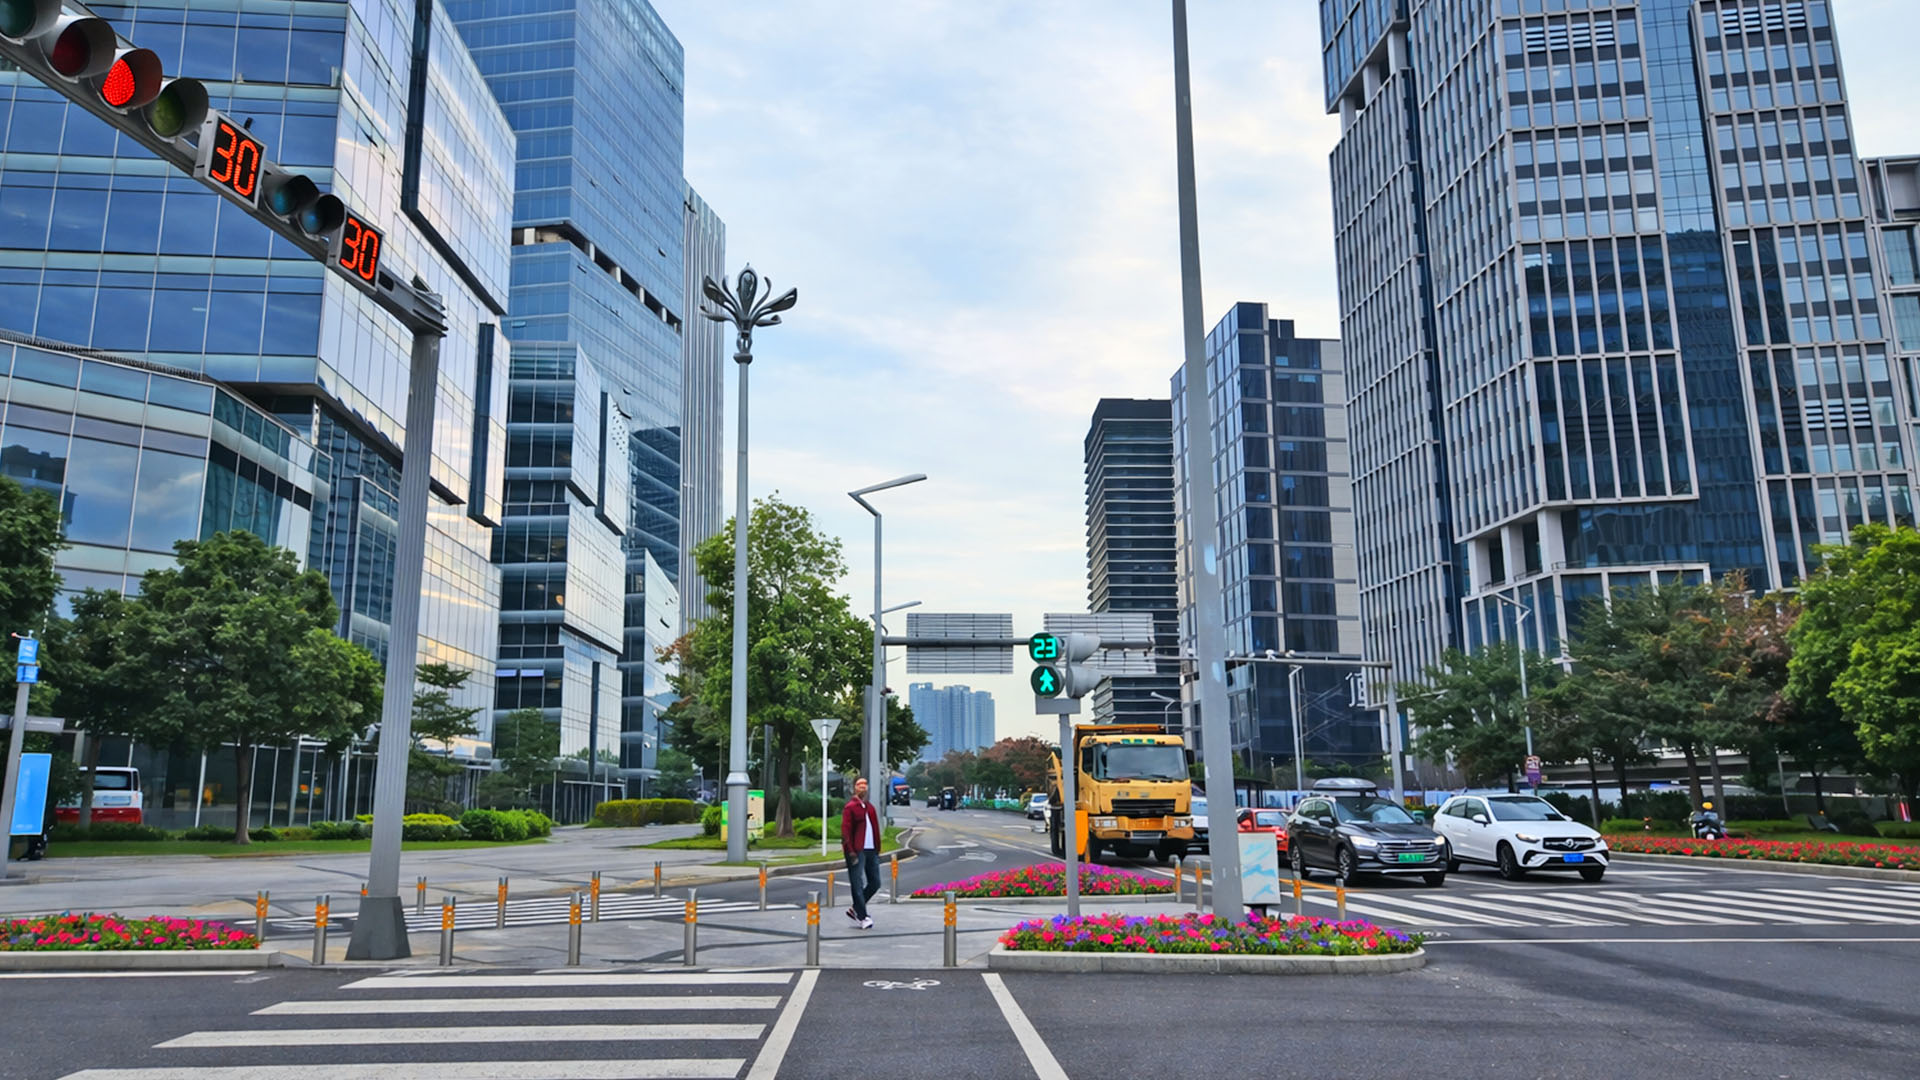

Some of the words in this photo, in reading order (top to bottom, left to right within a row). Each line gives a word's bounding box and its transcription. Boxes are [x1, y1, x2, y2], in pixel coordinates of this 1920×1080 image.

[211, 122, 259, 196] 30
[340, 217, 379, 280] 30
[1034, 637, 1057, 658] 23
